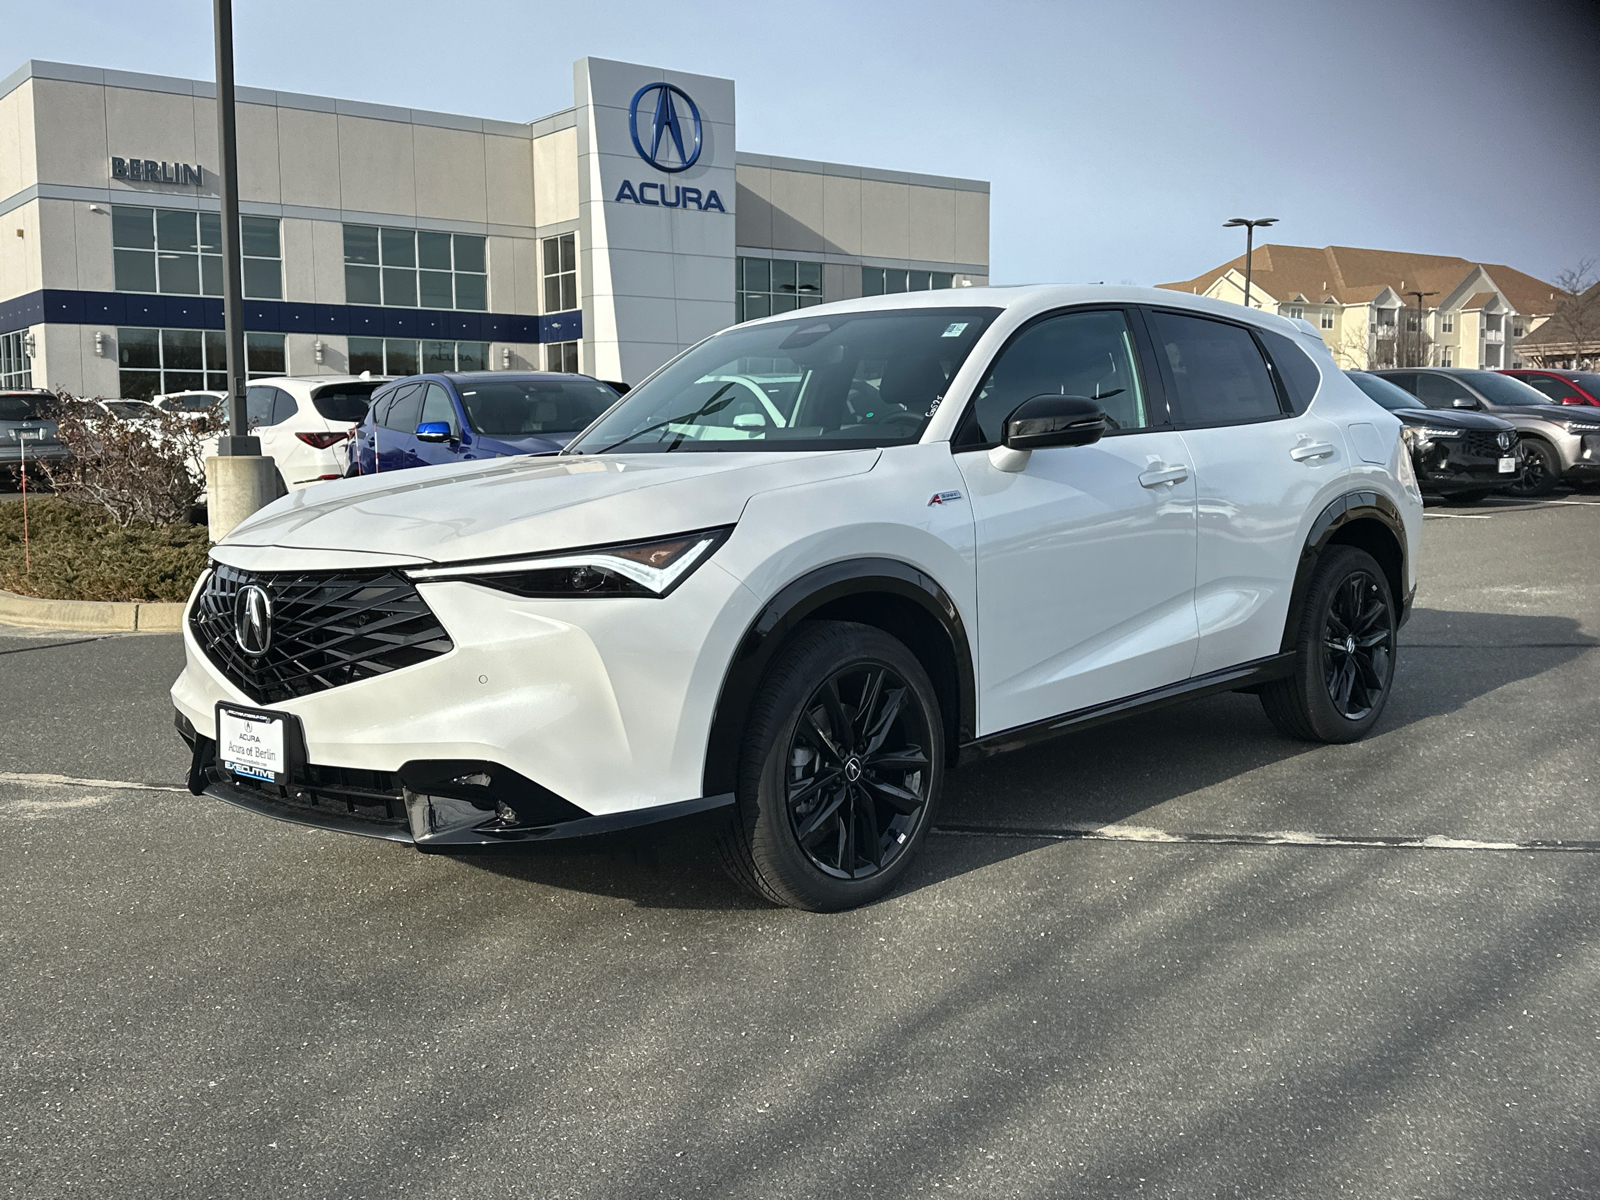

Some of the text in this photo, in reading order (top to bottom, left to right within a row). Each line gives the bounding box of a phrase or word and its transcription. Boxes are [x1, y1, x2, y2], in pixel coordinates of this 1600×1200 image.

[110, 156, 203, 186] BERLIN
[615, 179, 725, 213] ACURA
[239, 733, 260, 743] ACURA
[228, 741, 276, 761] Acura of Berlin
[225, 761, 275, 779] EXECUTIVE
